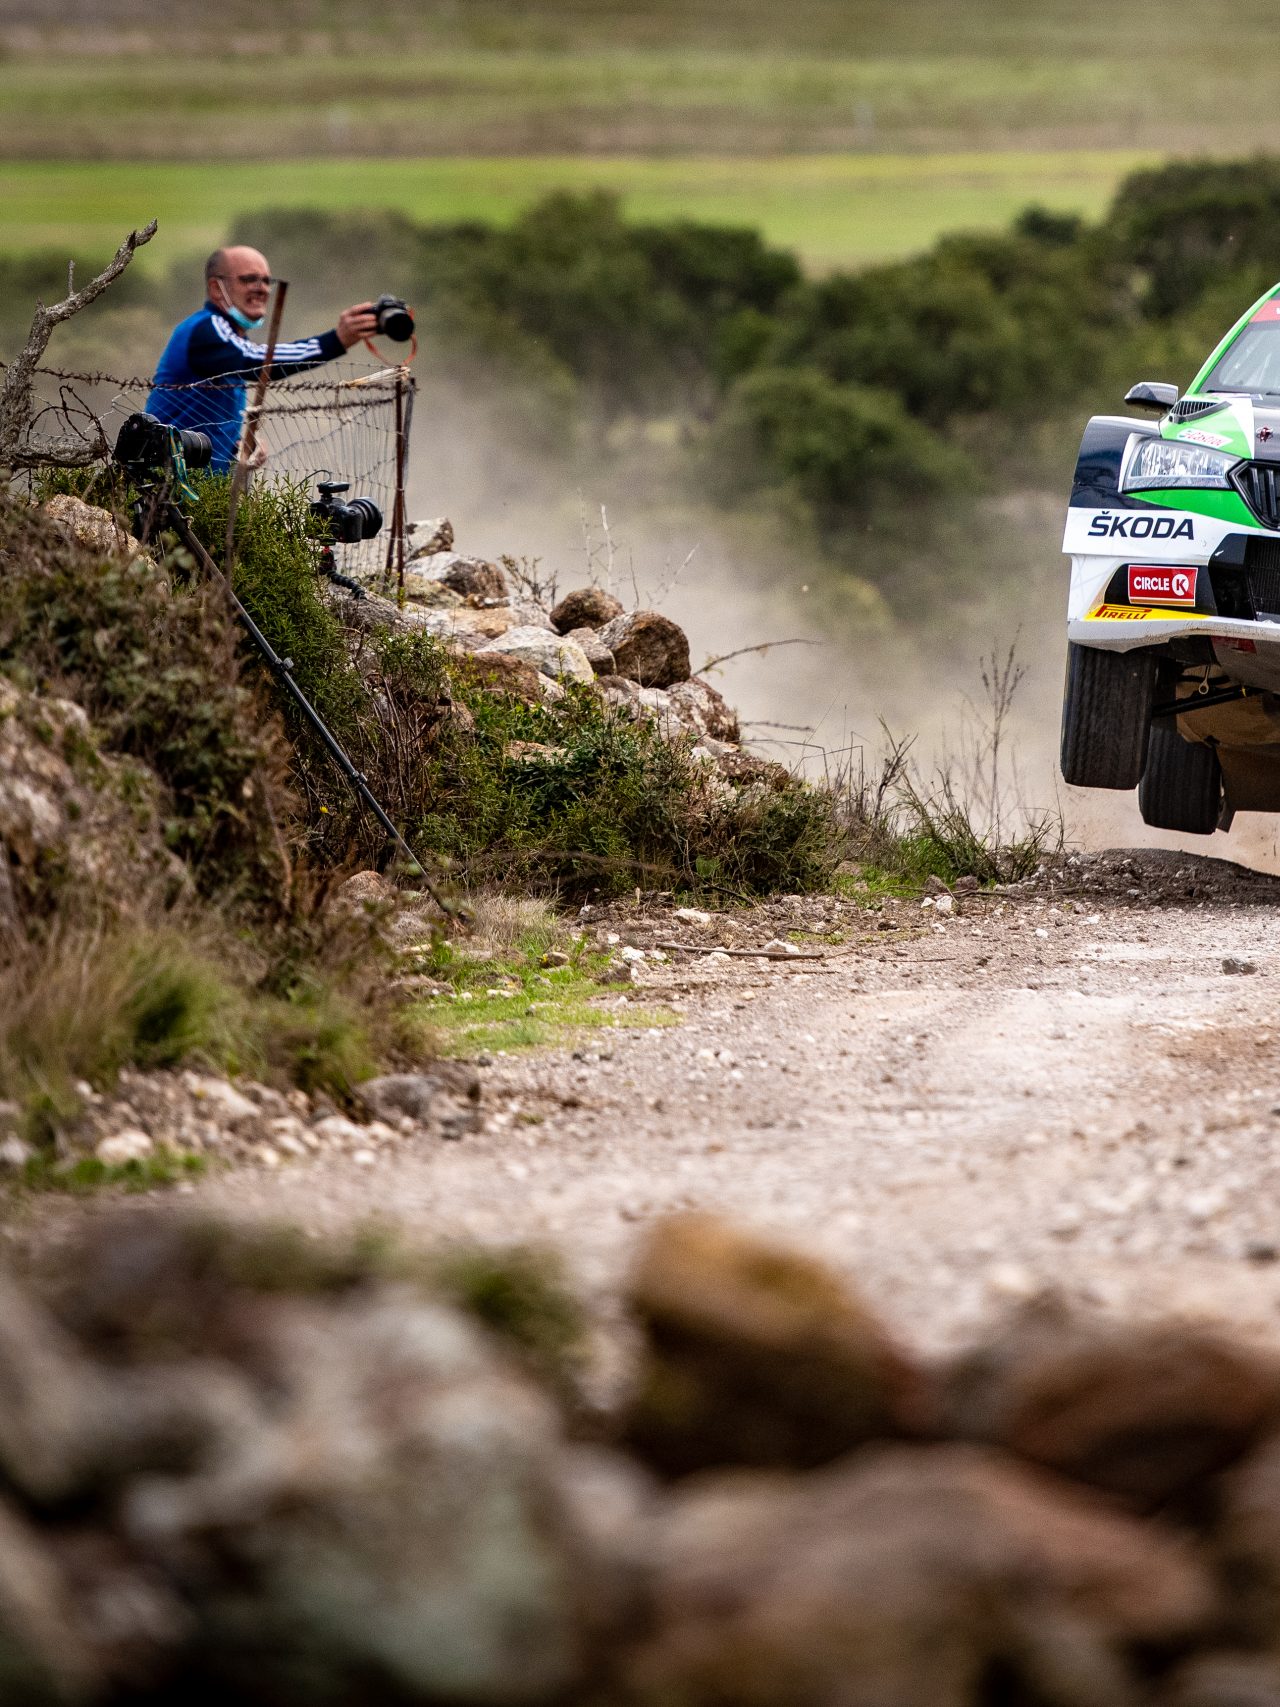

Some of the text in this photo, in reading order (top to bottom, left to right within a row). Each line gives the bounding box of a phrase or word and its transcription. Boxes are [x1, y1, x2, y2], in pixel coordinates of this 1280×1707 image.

[1087, 511, 1195, 540] ŠKODA
[1133, 575, 1189, 594] CIRCLE K
[1094, 605, 1152, 620] PIRELLI
